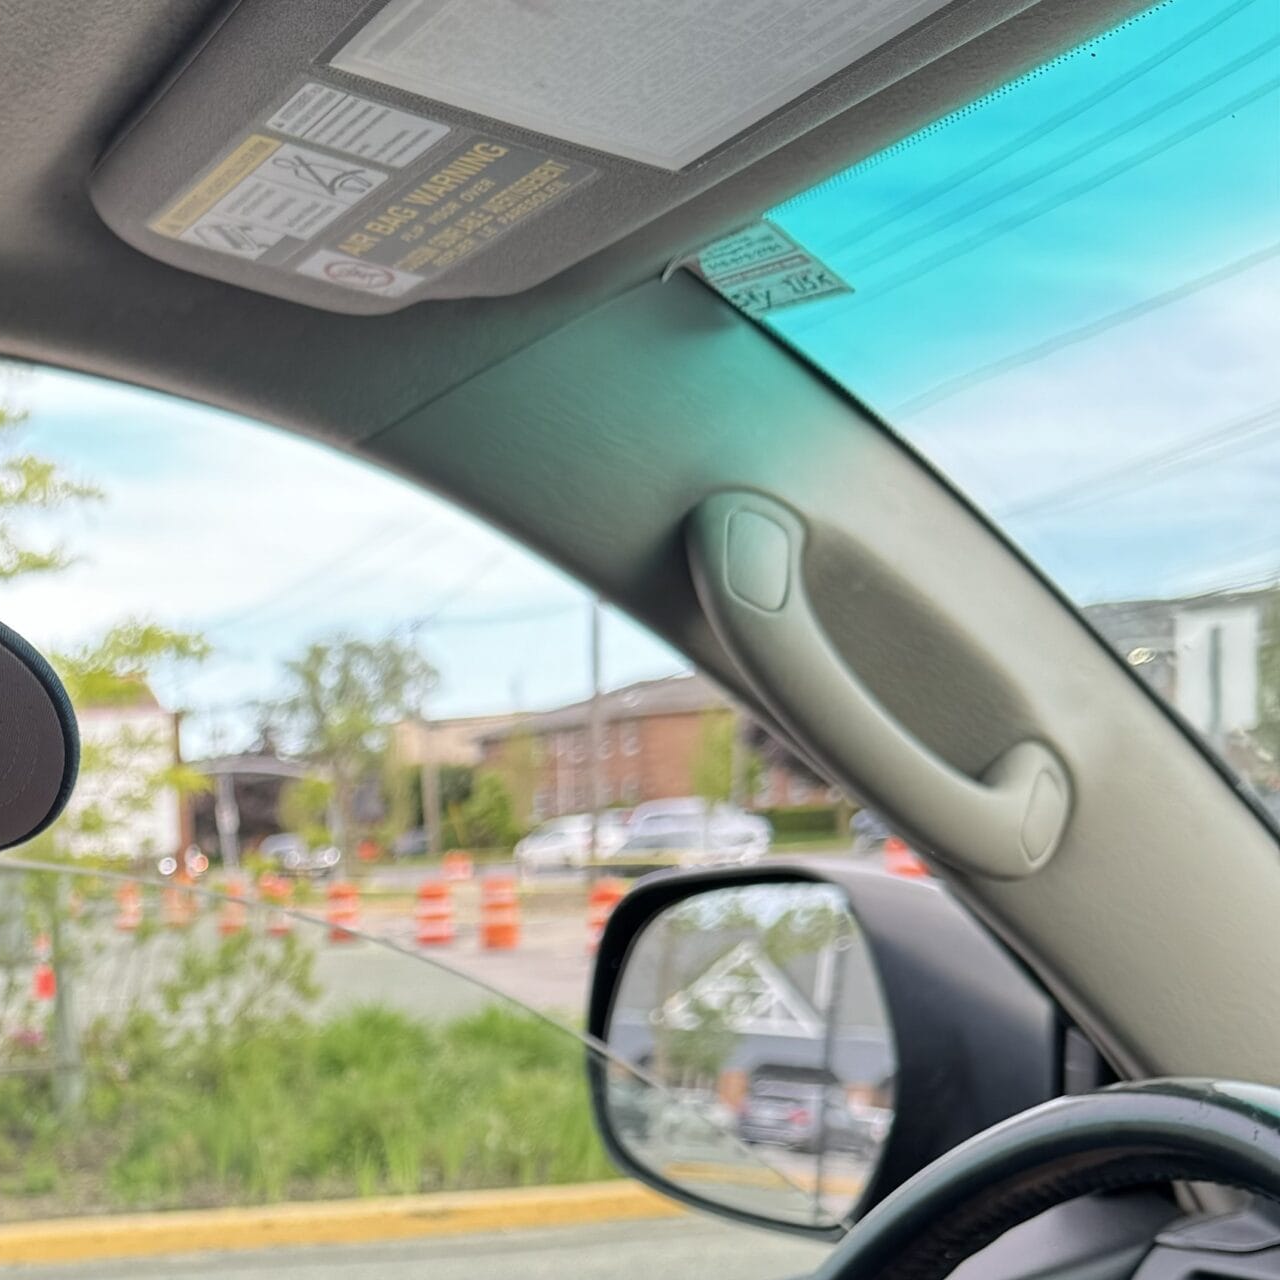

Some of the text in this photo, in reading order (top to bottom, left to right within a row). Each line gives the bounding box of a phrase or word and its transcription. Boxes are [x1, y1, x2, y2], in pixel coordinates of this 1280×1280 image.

[365, 203, 419, 236] BAG
[405, 142, 511, 206] WARNING
[459, 177, 497, 203] OVER
